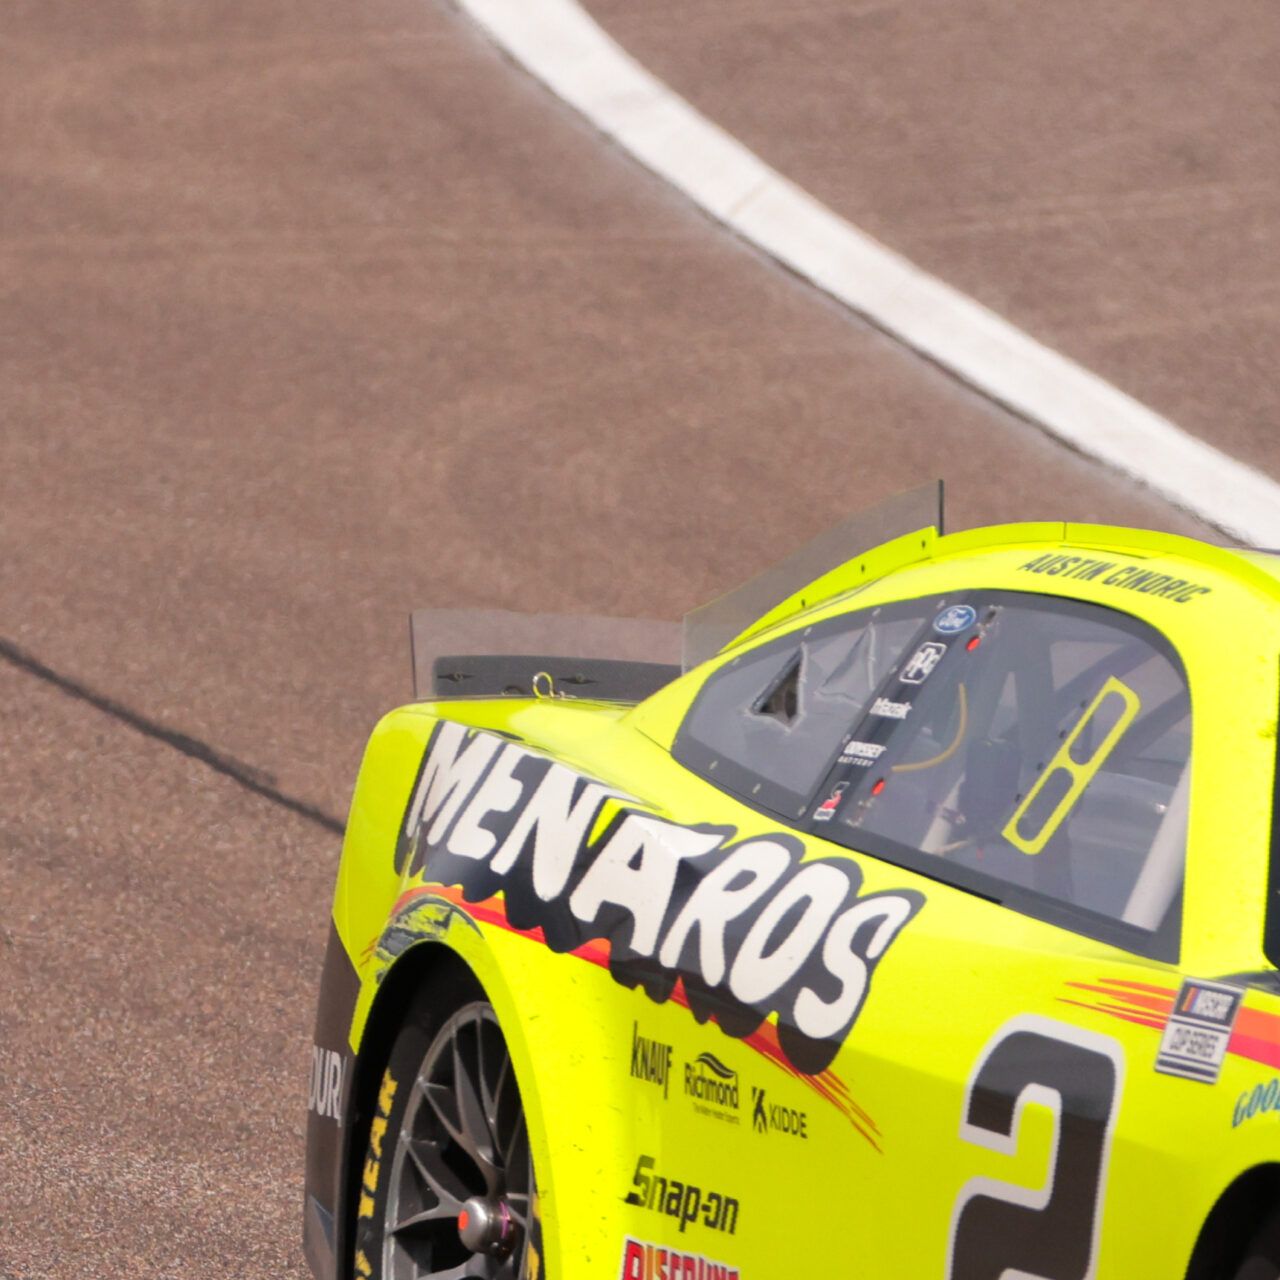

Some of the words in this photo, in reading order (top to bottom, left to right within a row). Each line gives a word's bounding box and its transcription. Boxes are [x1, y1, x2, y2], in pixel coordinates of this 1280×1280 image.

[1016, 553, 1117, 582] AUSTIN
[1102, 565, 1212, 604] CINDRIC
[630, 1019, 673, 1101] KNAUF
[684, 1062, 740, 1110] Richmond
[768, 1103, 808, 1139] KIDDE
[622, 1154, 740, 1236] Snap-on
